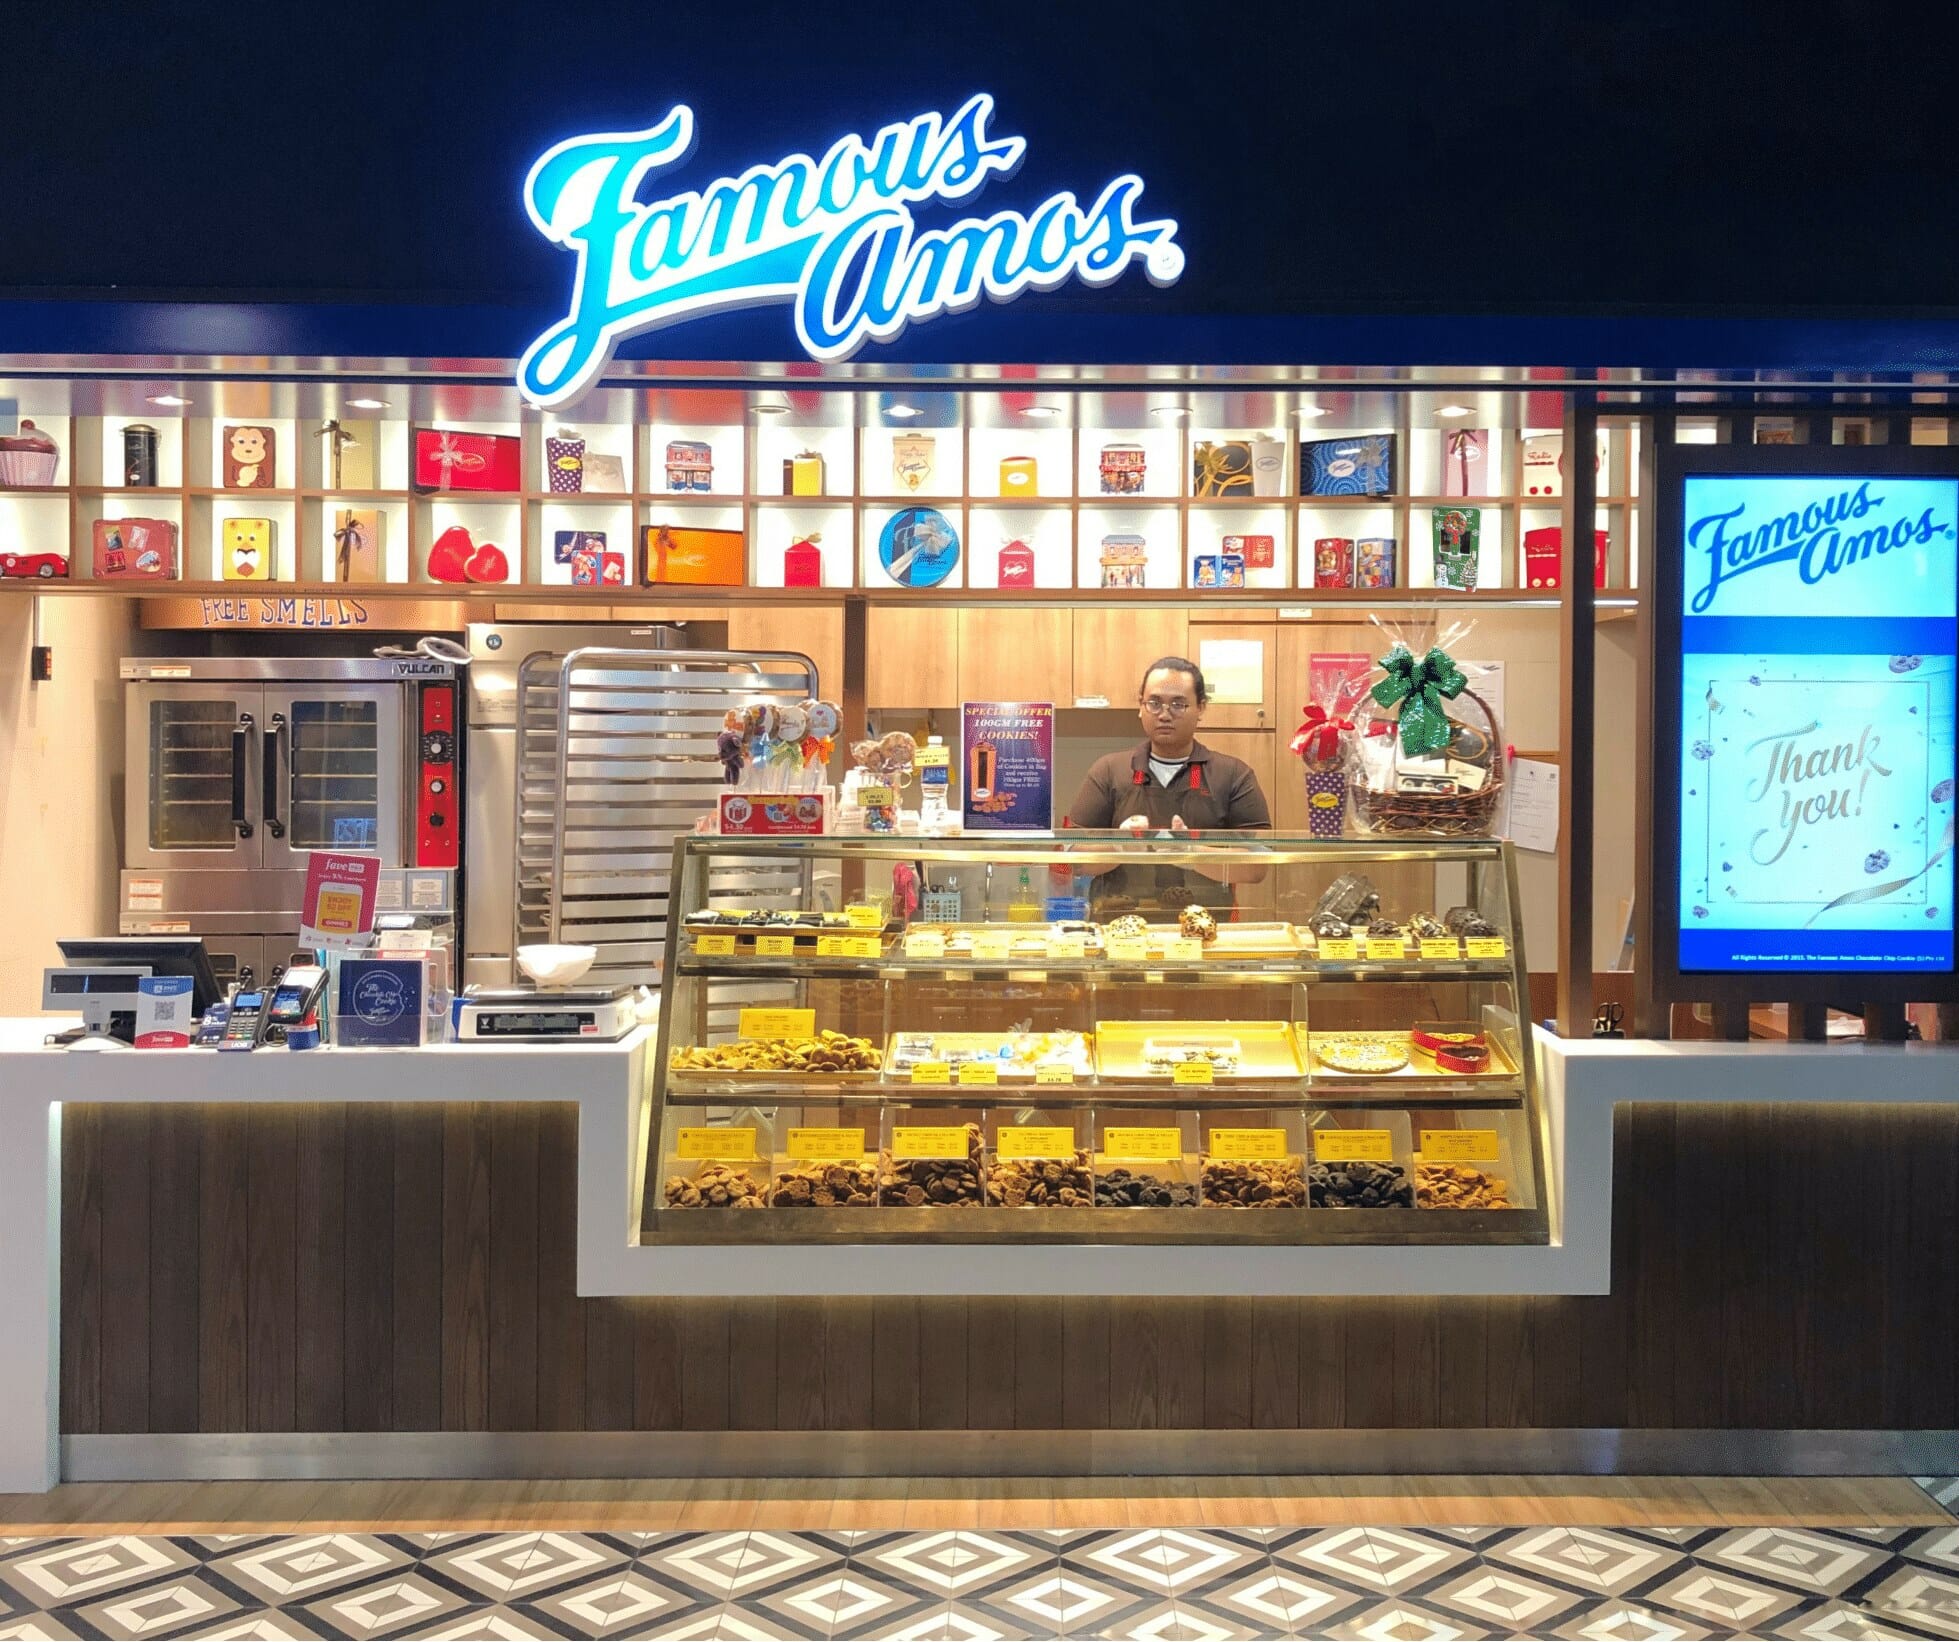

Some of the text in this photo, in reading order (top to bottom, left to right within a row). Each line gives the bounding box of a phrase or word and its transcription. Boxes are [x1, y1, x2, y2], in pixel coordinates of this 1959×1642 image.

[518, 93, 1027, 408] Famous
[796, 175, 1179, 360] Amos
[1688, 482, 1884, 613] Famous
[1799, 508, 1949, 585] Amos
[200, 599, 369, 626] FREE SMELLS
[398, 663, 446, 675] VULCAN
[974, 719, 1044, 728] 100GM FREE
[979, 731, 1039, 740] COOKIES!
[1015, 708, 1053, 716] OFFER
[1745, 720, 1892, 802] Thank
[1750, 769, 1869, 866] you!
[325, 858, 349, 871] fave
